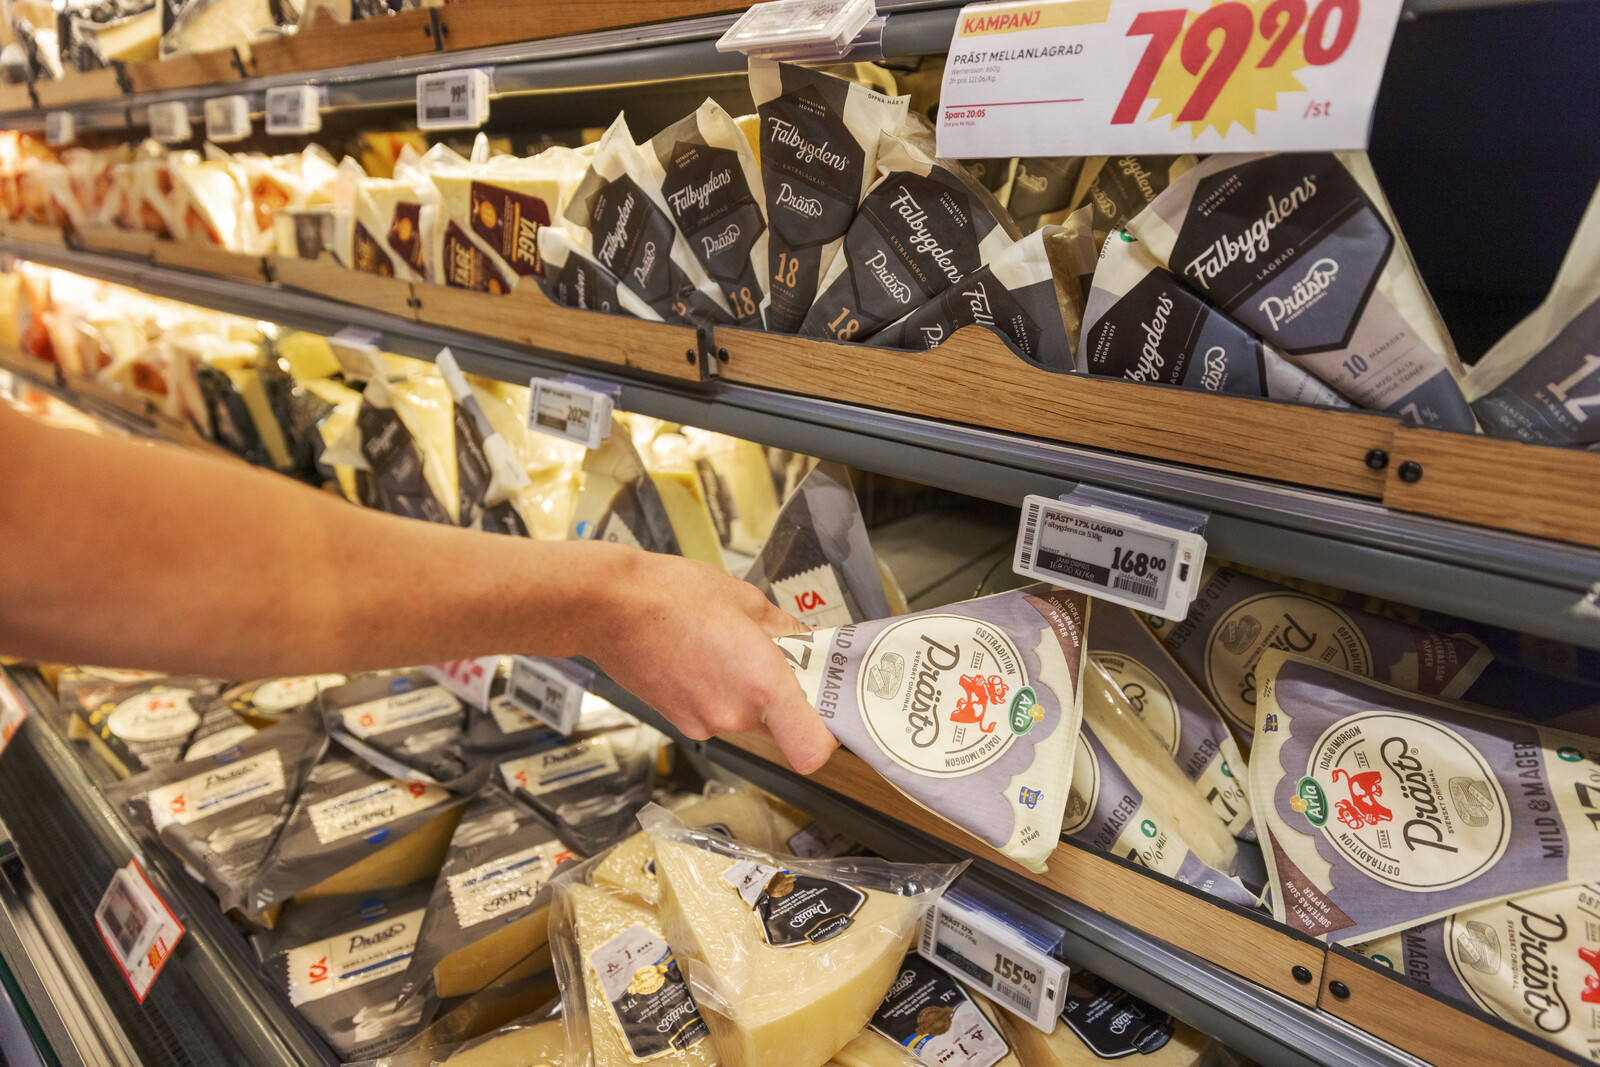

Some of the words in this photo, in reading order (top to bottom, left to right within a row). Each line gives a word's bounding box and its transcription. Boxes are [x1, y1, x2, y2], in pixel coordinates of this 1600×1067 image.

[963, 10, 1041, 34] KAMPANJ
[953, 51, 988, 65] PRÄST
[988, 43, 1084, 62] MELLANLAGRAD
[867, 93, 885, 104] ÖPPNA
[944, 110, 966, 120] Spara
[966, 109, 986, 118] 20:05
[1303, 100, 1332, 119] /st
[768, 116, 847, 171] Falbygdens
[668, 168, 731, 216] Falbygdens
[776, 182, 822, 218] Präst
[939, 197, 954, 216] SEDAN
[943, 191, 968, 224] OSTMÄSTARE
[1197, 174, 1239, 213] OSTMÄSTARE
[1203, 196, 1226, 217] SEDAN
[701, 224, 740, 259] Präst
[890, 185, 964, 285] Falbygdens
[1184, 176, 1317, 290] Falbygdens
[774, 252, 799, 288] 18
[890, 235, 927, 283] EXTRALAGRAD
[1256, 247, 1295, 281] LAGRAD
[865, 250, 911, 304] Präst
[730, 287, 756, 318] 18
[1259, 258, 1339, 332] Präst
[827, 306, 859, 341] 18
[1123, 294, 1174, 382] bygdens
[1092, 321, 1111, 362] OSTMÄSTARE
[1100, 341, 1112, 364] SEDAN
[1170, 352, 1185, 386] AGRAD
[1342, 353, 1369, 379] 10
[1044, 520, 1078, 537] Falbygdens
[1078, 529, 1086, 537] ca
[1086, 531, 1103, 543] 538g
[1074, 518, 1090, 529] 17%
[1090, 522, 1124, 537] LAGRAD
[1050, 559, 1074, 574] 168.00
[795, 590, 826, 614] ICA
[1064, 598, 1082, 627] LOCKET
[1048, 596, 1075, 633] SORTERAS
[1070, 630, 1079, 648] SOM
[1049, 611, 1068, 638] PAPPER
[831, 652, 848, 666] &
[908, 650, 922, 684] SVENSKT
[972, 651, 982, 669] SEDAN
[974, 627, 1016, 676] OSTTRADITION
[819, 666, 845, 719] MAGER
[901, 681, 914, 712] ORIGINAL
[908, 634, 960, 748] Präst
[1013, 692, 1037, 728] Arla
[1513, 742, 1546, 796] MAGER
[1308, 785, 1323, 819] Arla
[1380, 737, 1458, 853] Präst
[1431, 769, 1443, 805] ORIGINAL
[1102, 795, 1138, 840] MAGER
[1442, 806, 1455, 834] SVENSKT
[1528, 799, 1551, 812] &
[1156, 832, 1168, 850] HALT
[1339, 833, 1400, 877] OSTTRADITION
[1535, 817, 1564, 859] MILD
[1285, 880, 1301, 895] SOM
[1303, 887, 1331, 914] PAPPER
[790, 900, 832, 928] Präst
[1292, 905, 1315, 930] LOCKET
[1298, 890, 1332, 927] SORTERAS
[1506, 920, 1516, 951] SVENSKT
[1506, 900, 1571, 1033] Präst
[1510, 950, 1518, 990] ORIGINAL
[656, 996, 698, 1033] Präst
